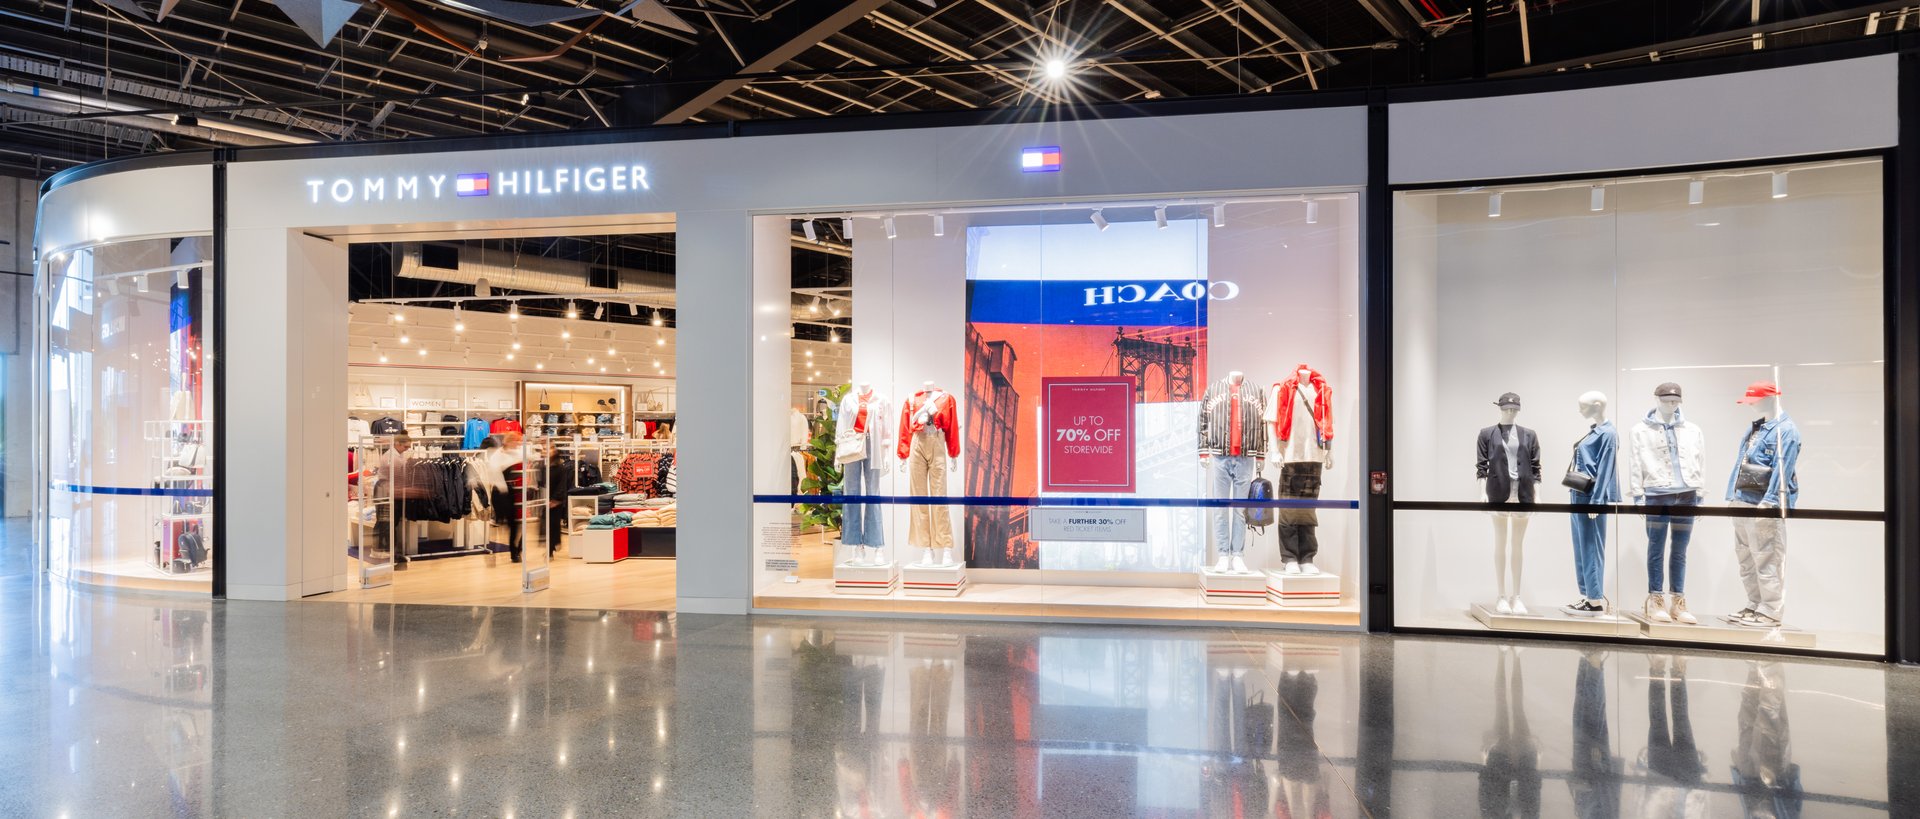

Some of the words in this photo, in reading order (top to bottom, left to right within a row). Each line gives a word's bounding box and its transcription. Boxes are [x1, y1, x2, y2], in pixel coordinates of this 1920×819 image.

[306, 174, 446, 203] TOMMY
[498, 165, 650, 196] HILFIGER
[1073, 415, 1086, 426] UP
[1089, 415, 1104, 426] TO
[1056, 428, 1091, 442] 70%
[1094, 428, 1121, 442] OFF
[1064, 445, 1113, 454] STOREWIDE
[1115, 518, 1127, 526] OFF
[1063, 525, 1075, 533] RED
[1075, 525, 1094, 533] TICKET
